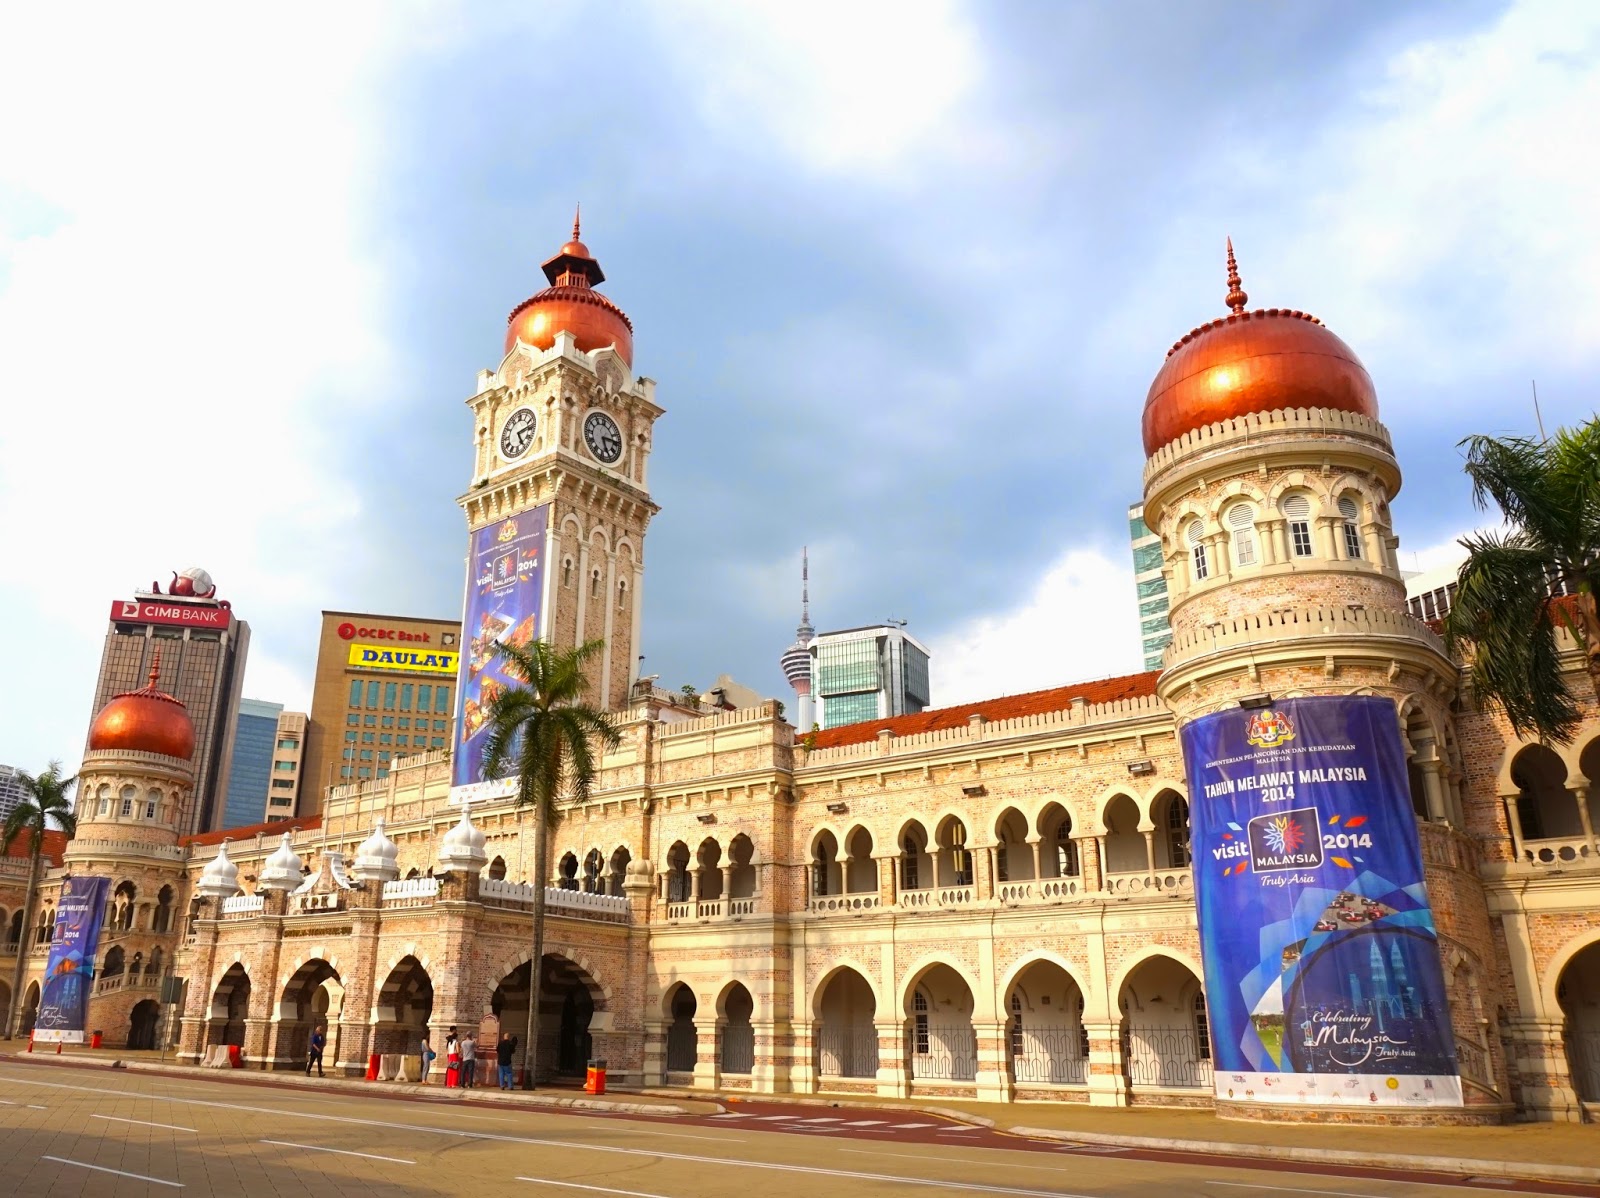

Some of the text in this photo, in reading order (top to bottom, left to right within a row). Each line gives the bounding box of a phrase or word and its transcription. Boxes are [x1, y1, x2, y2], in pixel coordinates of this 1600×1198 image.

[518, 558, 538, 572] 2014
[476, 573, 493, 587] visit
[144, 606, 219, 622] CIMB BANK
[358, 627, 431, 643] OCBC Bank
[362, 649, 453, 668] DAULAT
[1205, 744, 1356, 769] KEMENTERIAN PELANCONGAN DAN KEBUDAYAAN
[1256, 755, 1292, 765] MALAYSIA
[1204, 767, 1367, 799] TAHUN MELAWAT MALAYSIA
[1261, 786, 1296, 803] 2014
[1322, 833, 1373, 850] 2014
[1212, 841, 1250, 861] visit
[1256, 853, 1319, 867] MALAYSIA
[1260, 873, 1316, 887] Truly Asia
[1312, 1009, 1372, 1030] Celebrating
[1375, 1046, 1416, 1062] Truly Asia
